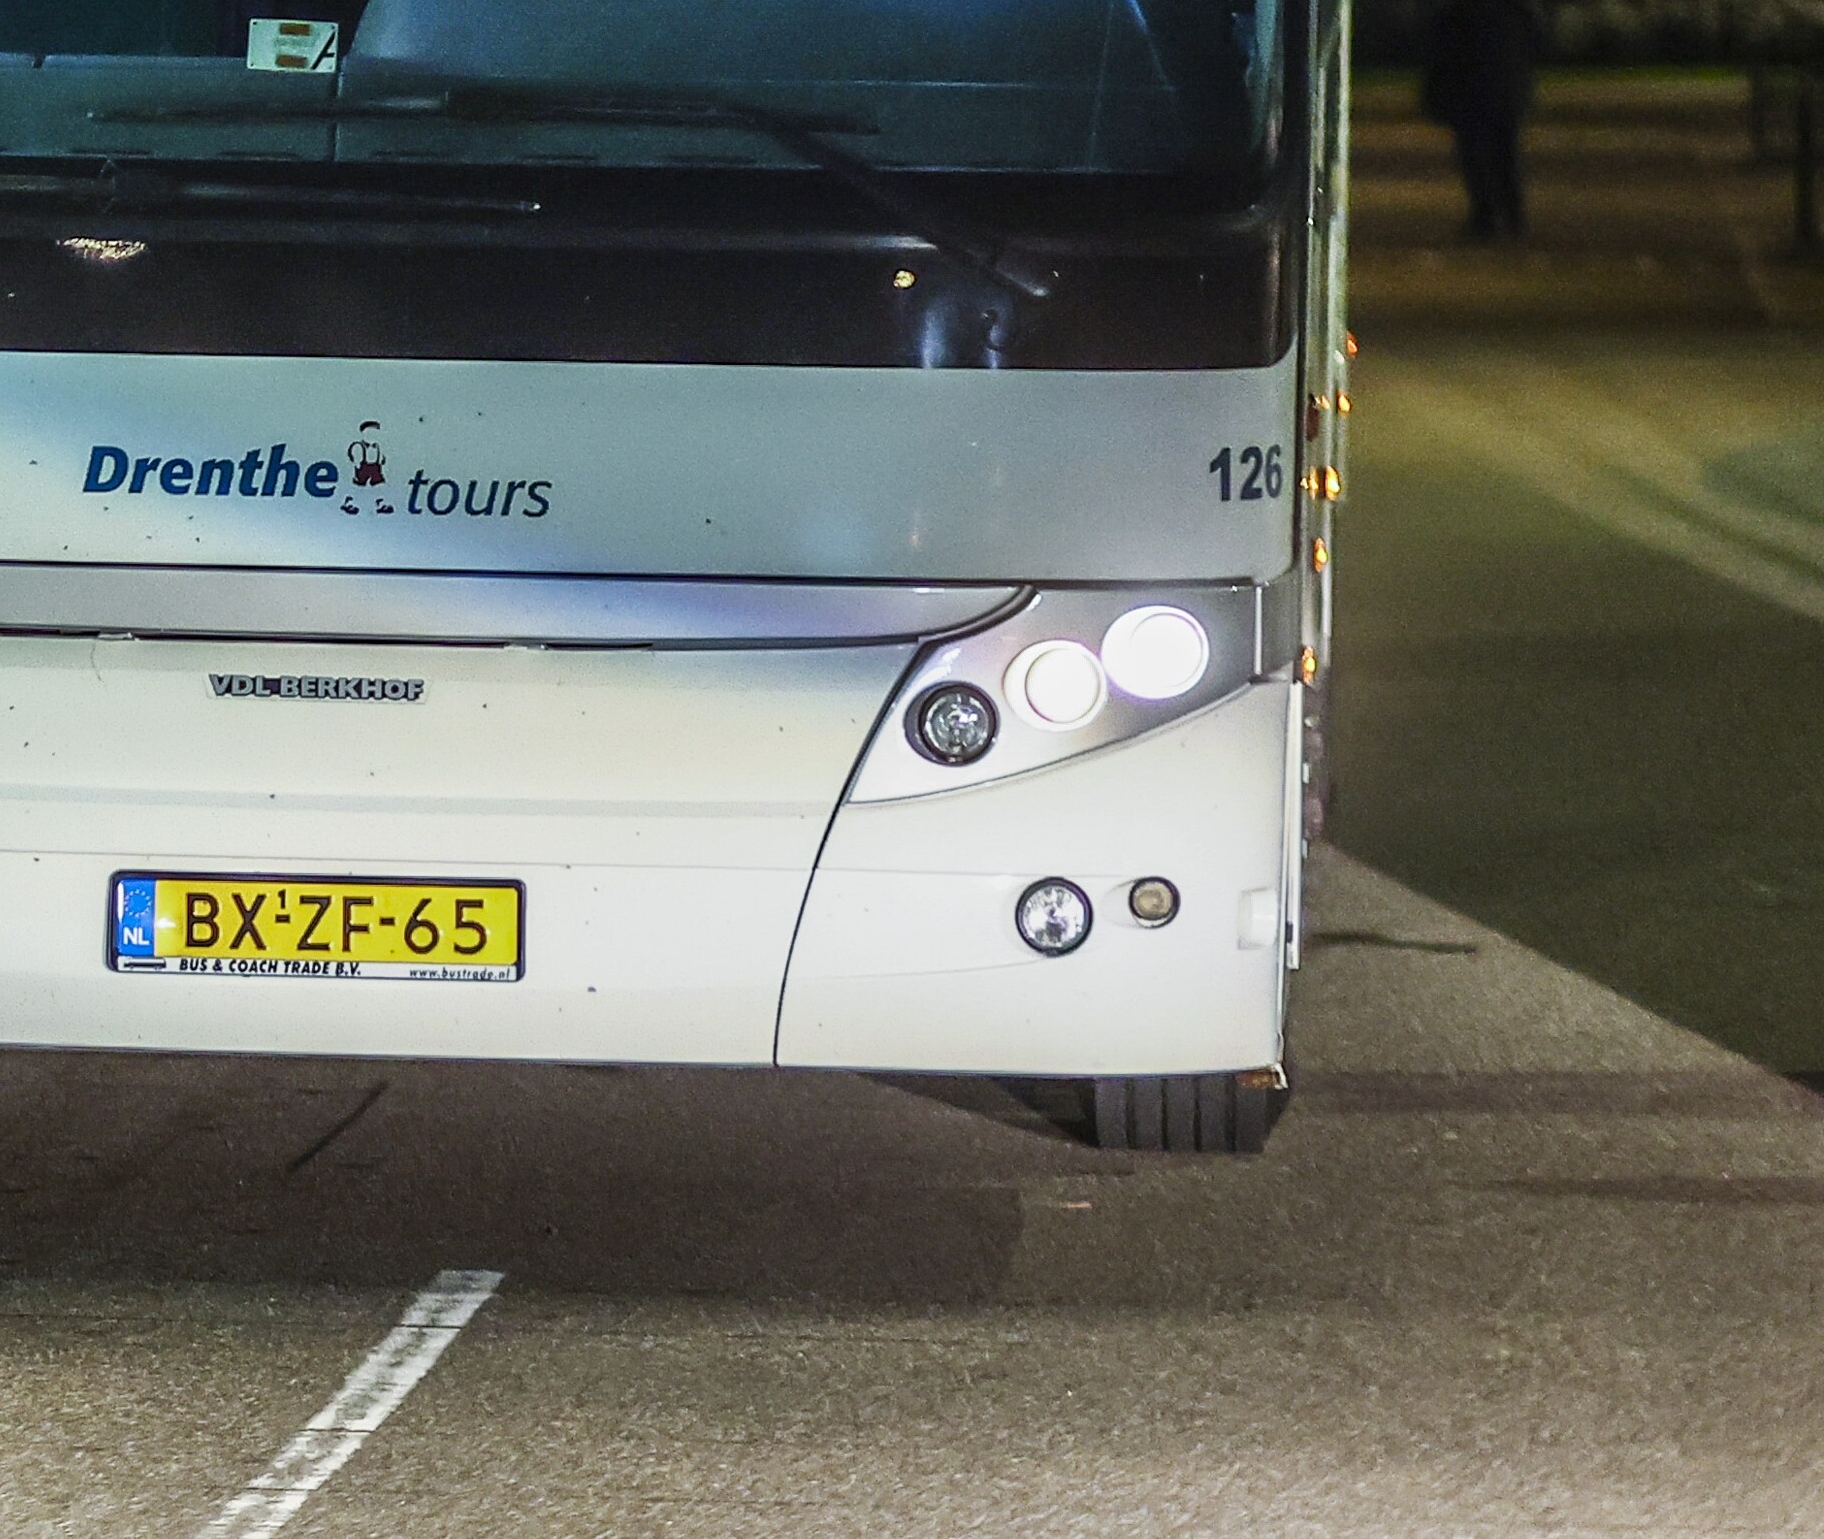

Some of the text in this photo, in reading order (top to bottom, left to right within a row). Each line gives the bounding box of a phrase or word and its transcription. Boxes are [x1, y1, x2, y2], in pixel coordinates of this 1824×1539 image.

[82, 443, 554, 519] Drenthe tours
[1209, 443, 1283, 502] 126
[208, 673, 425, 701] VDL BERKHOF
[122, 925, 150, 946] NL
[184, 891, 489, 955] BX-ZF-65
[179, 958, 361, 977] BUS & COACH TRADE B.V.
[409, 966, 511, 981] www.bustrade.nl
